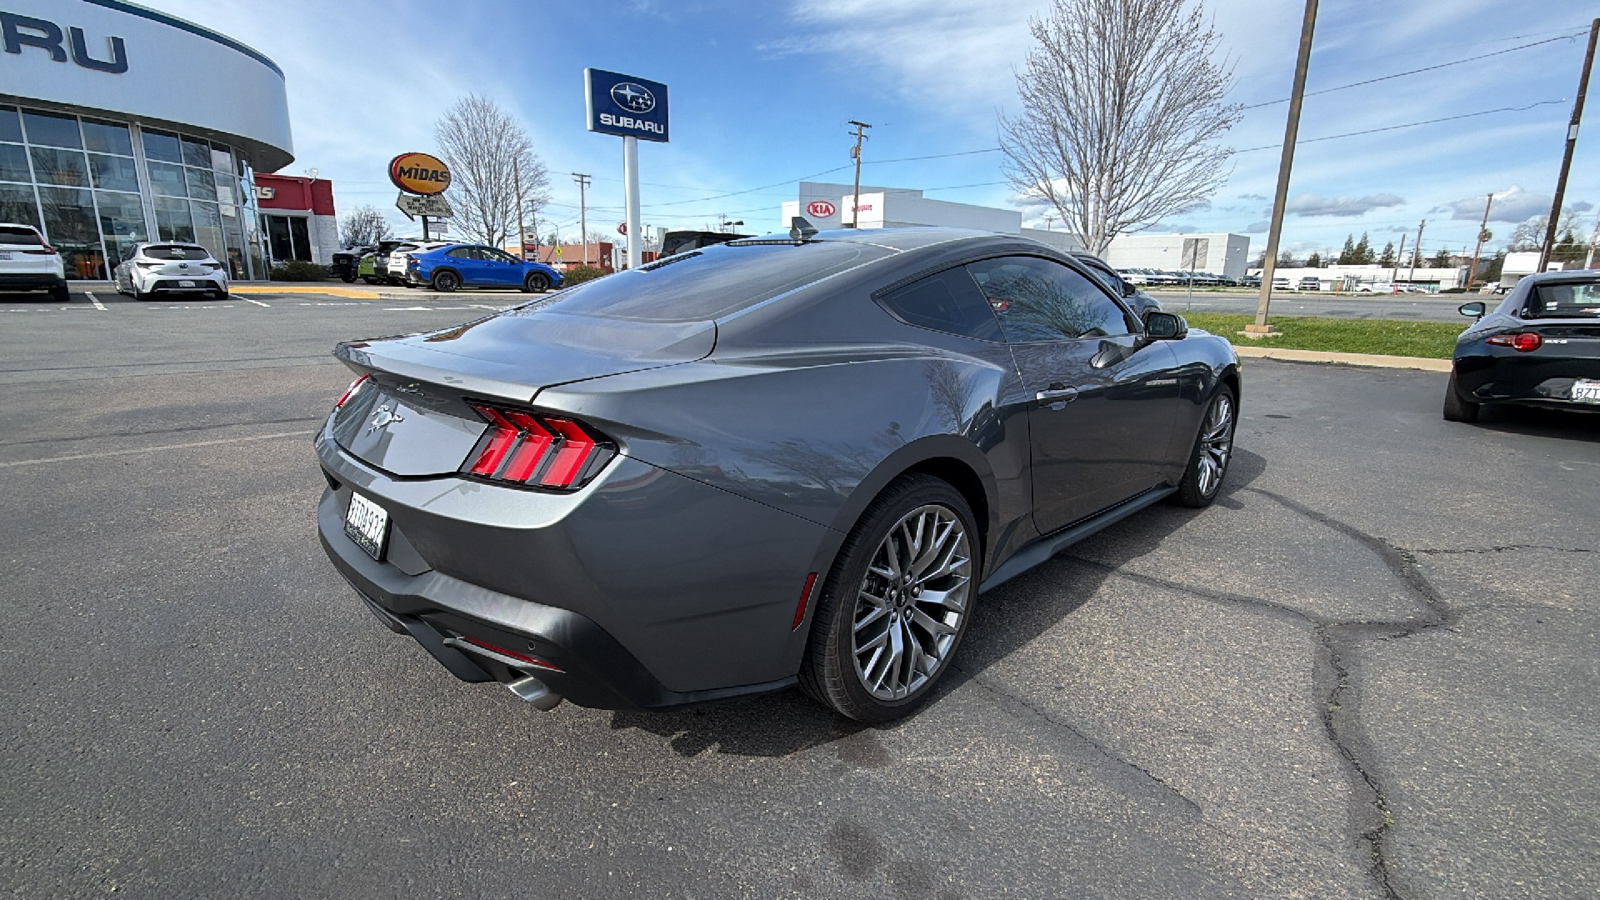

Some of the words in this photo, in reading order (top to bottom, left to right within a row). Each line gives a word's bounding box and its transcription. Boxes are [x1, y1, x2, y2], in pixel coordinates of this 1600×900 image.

[600, 113, 664, 134] SUBARU
[398, 163, 450, 182] MIDAS
[812, 204, 831, 215] KIA
